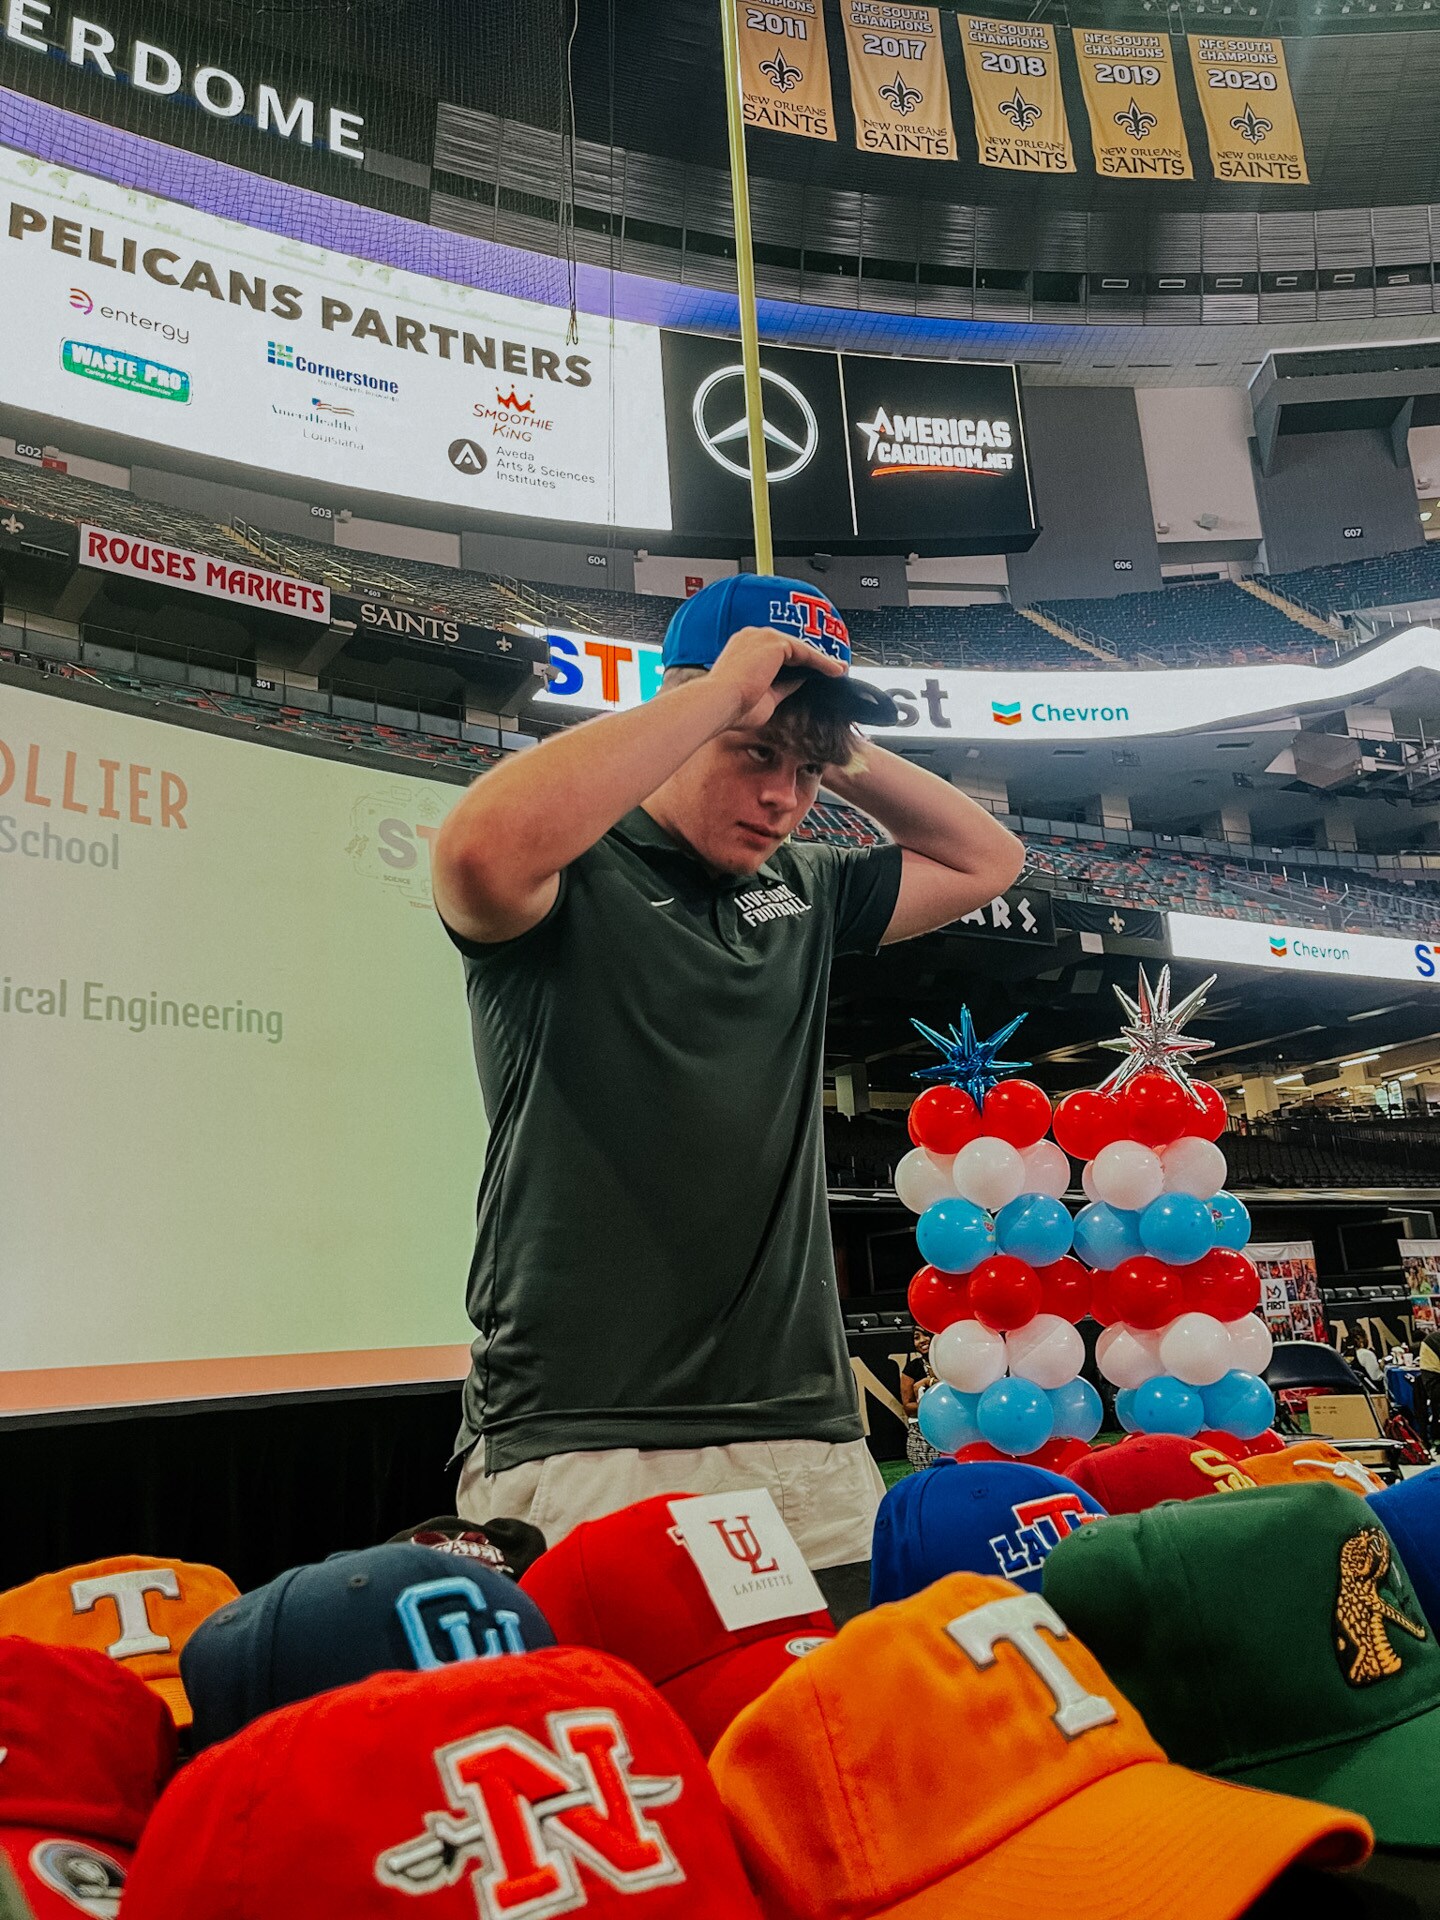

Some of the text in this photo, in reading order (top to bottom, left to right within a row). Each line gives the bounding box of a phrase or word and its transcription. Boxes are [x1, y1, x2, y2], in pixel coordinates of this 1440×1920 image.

[758, 0, 815, 15] MPIONS
[852, 2, 929, 21] NFC SOUTH
[746, 8, 808, 41] 2011
[850, 14, 933, 33] CHAMPIONS
[969, 19, 1044, 37] NFC SOUTH
[862, 33, 927, 61] 2017
[968, 31, 1049, 50] CHAMPIONS
[1083, 33, 1160, 48] NFC SOUTH
[1083, 44, 1165, 59] CHAMPIONS
[1198, 39, 1273, 53] NFC SOUTH
[981, 51, 1046, 77] 2018
[1198, 50, 1278, 65] CHAMPIONS
[5, 0, 366, 160] ERDOME
[1094, 63, 1161, 86] 2019
[1207, 68, 1279, 91] 2020
[743, 92, 827, 117] NEW ORLEANS
[743, 104, 828, 135] SAINTS
[863, 119, 948, 138] NEW ORLEANS
[864, 130, 949, 156] SAINTS
[985, 136, 1065, 151] NEW ORLEANS
[1100, 147, 1182, 159] NEW ORLEANS
[985, 146, 1067, 170] SAINTS
[1102, 156, 1185, 176] SAINTS
[1217, 151, 1299, 163] NEW ORLEANS
[1220, 161, 1302, 180] SAINTS
[8, 202, 593, 388] PELICANS PARTNERS
[100, 305, 190, 344] entergy
[71, 343, 183, 391] WASTE PRO
[295, 356, 399, 395] Cornerstone
[472, 403, 554, 431] SMOOTHIE
[856, 406, 1012, 448] AMERICAS
[302, 428, 365, 451] Louisiana
[16, 444, 43, 459] 602
[496, 446, 535, 462] Aveda
[497, 458, 596, 484] Arts & Sciences
[497, 470, 556, 490] Institutes
[310, 506, 333, 519] 603
[1343, 528, 1363, 539] 607
[587, 554, 608, 567] 604
[1113, 560, 1133, 571] 606
[88, 531, 325, 614] ROUSES MARKETS
[860, 577, 880, 588] 605
[360, 603, 460, 643] SAINTS
[769, 600, 803, 627] LA
[256, 679, 272, 690] 301
[1031, 703, 1130, 722] Chevron
[0, 815, 119, 870] School
[742, 896, 812, 928] FOOTBALL
[1293, 940, 1350, 960] Chevron
[1414, 943, 1440, 978] S
[82, 981, 284, 1044] Engineering
[1266, 1301, 1286, 1311] FIRST
[708, 1515, 780, 1575] UL
[733, 1574, 794, 1597] LAFAYETTE
[72, 1568, 181, 1660] T
[945, 1592, 1118, 1740] T
[433, 1706, 686, 1920] N
